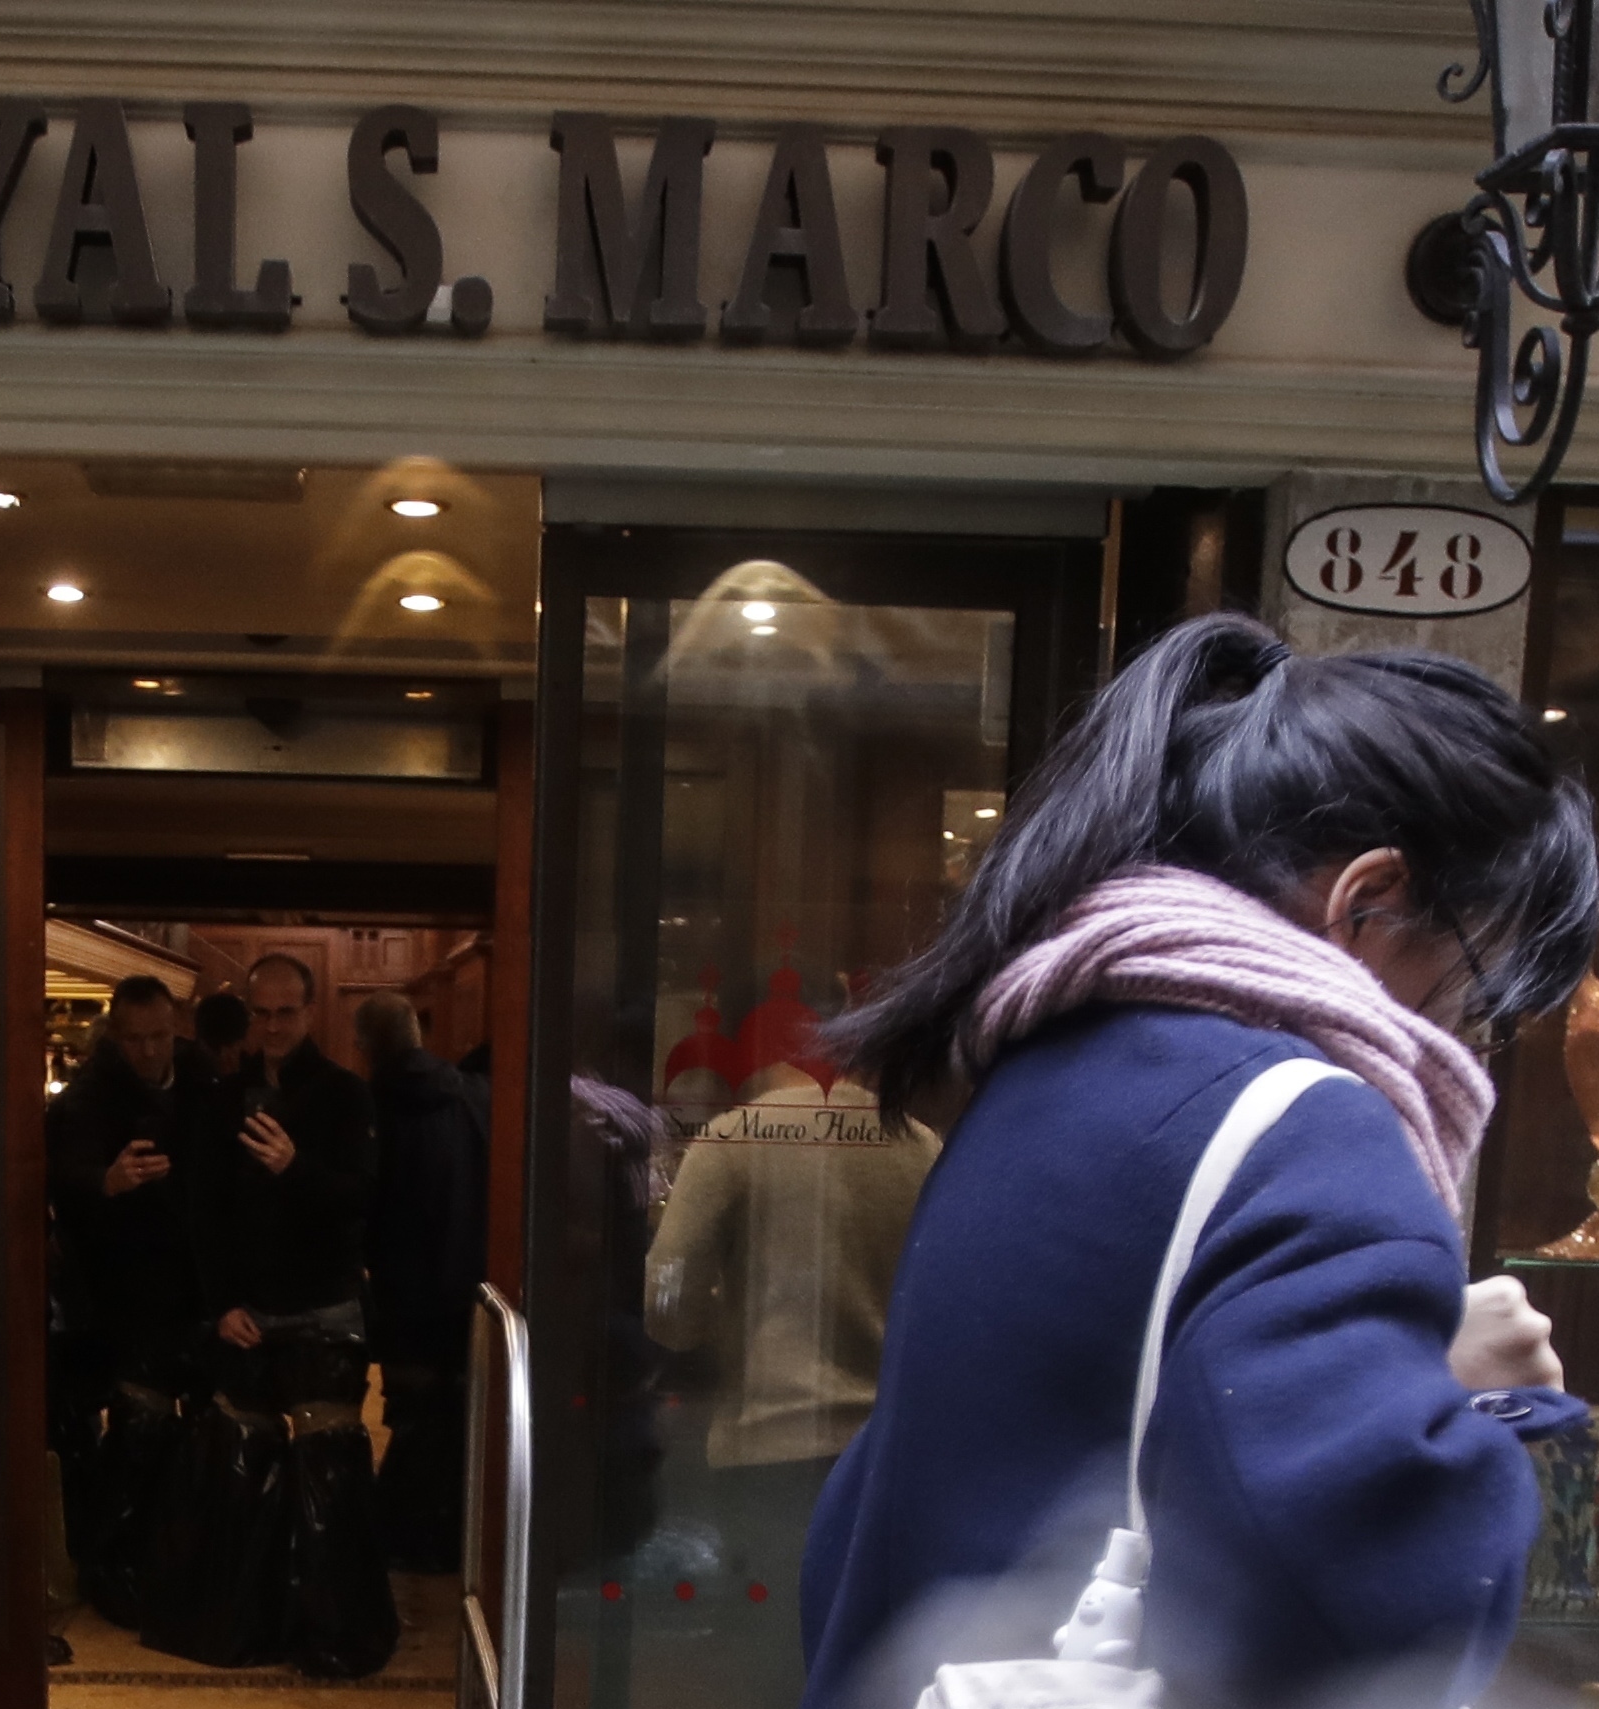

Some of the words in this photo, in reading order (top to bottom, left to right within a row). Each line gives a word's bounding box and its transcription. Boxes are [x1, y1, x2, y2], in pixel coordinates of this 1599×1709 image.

[346, 104, 493, 338] S.
[543, 110, 1248, 360] MARCO
[1319, 526, 1483, 600] 848
[669, 1106, 710, 1139] San
[718, 1108, 807, 1141] Marco
